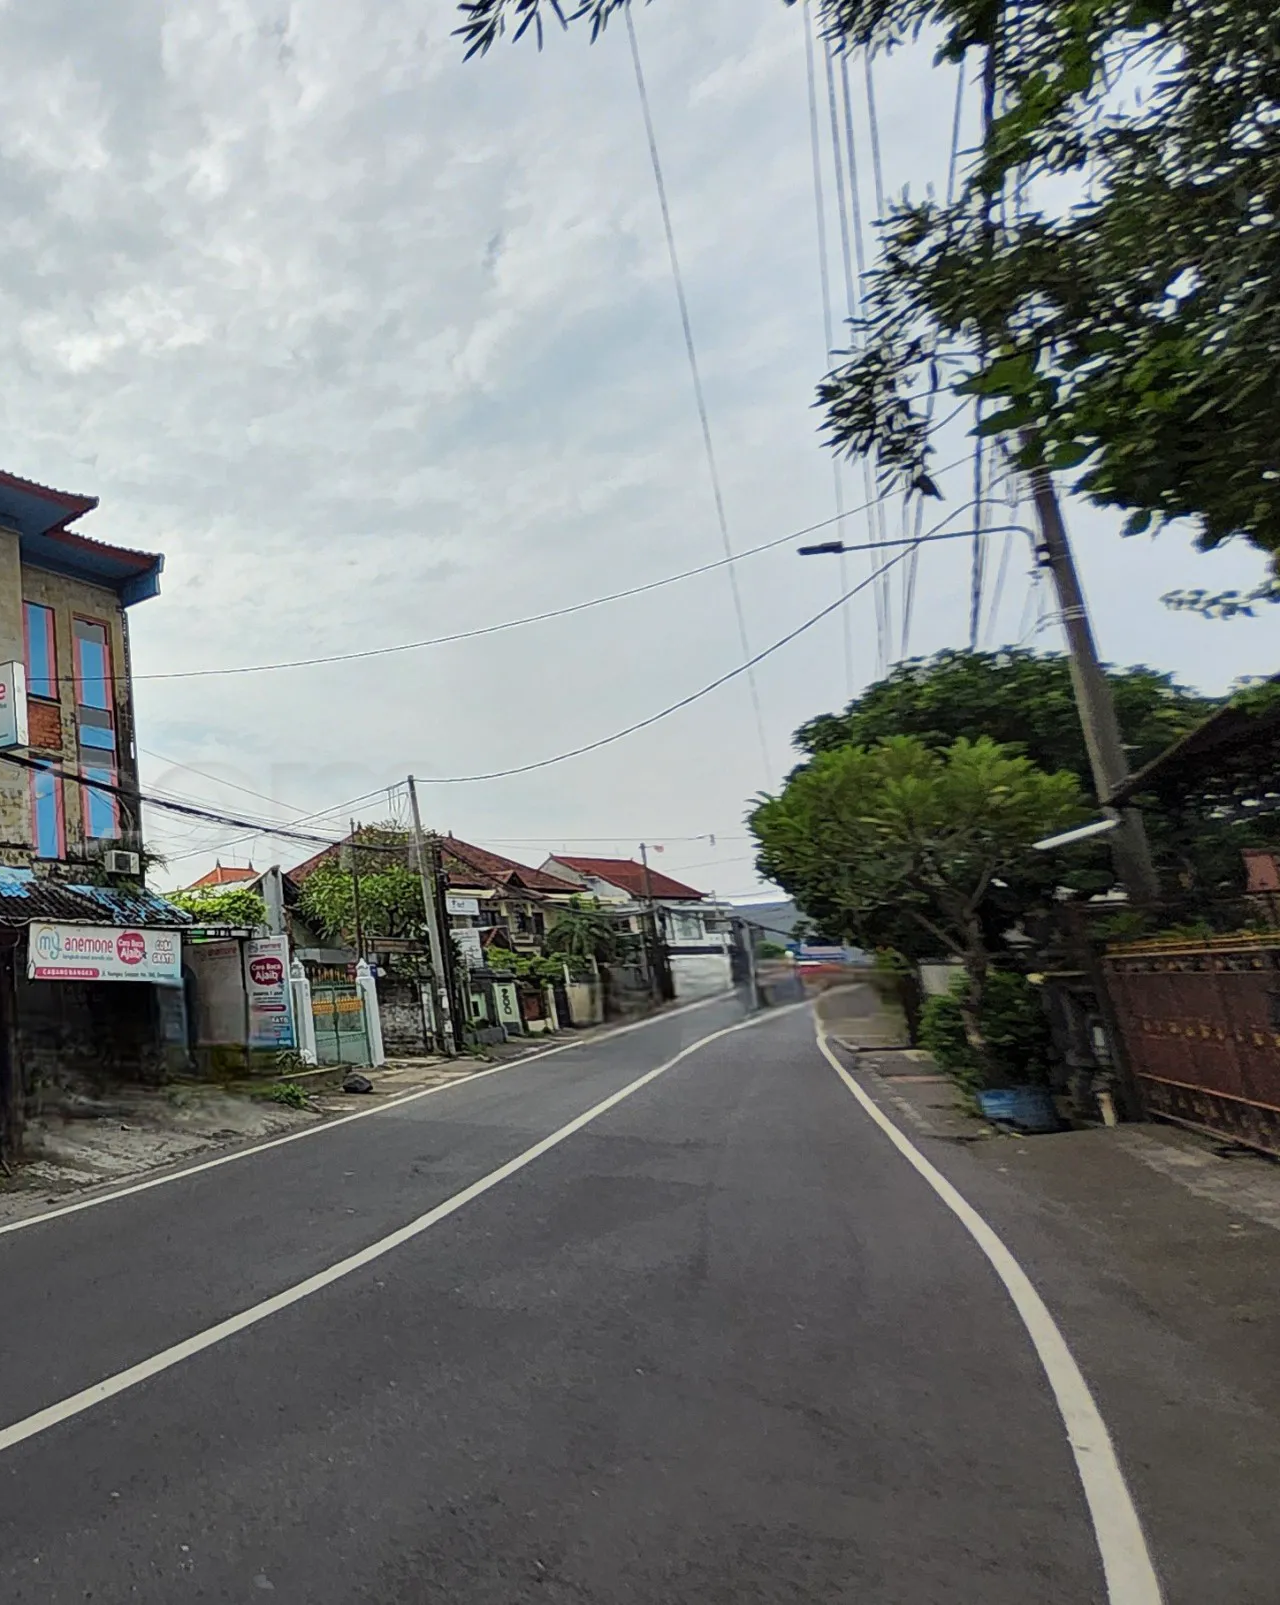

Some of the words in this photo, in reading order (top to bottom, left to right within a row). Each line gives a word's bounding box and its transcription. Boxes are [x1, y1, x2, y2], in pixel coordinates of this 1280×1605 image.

[39, 929, 62, 960] my
[64, 936, 113, 953] anemone
[120, 947, 143, 959] Ajaib
[255, 970, 278, 981] Ajaib
